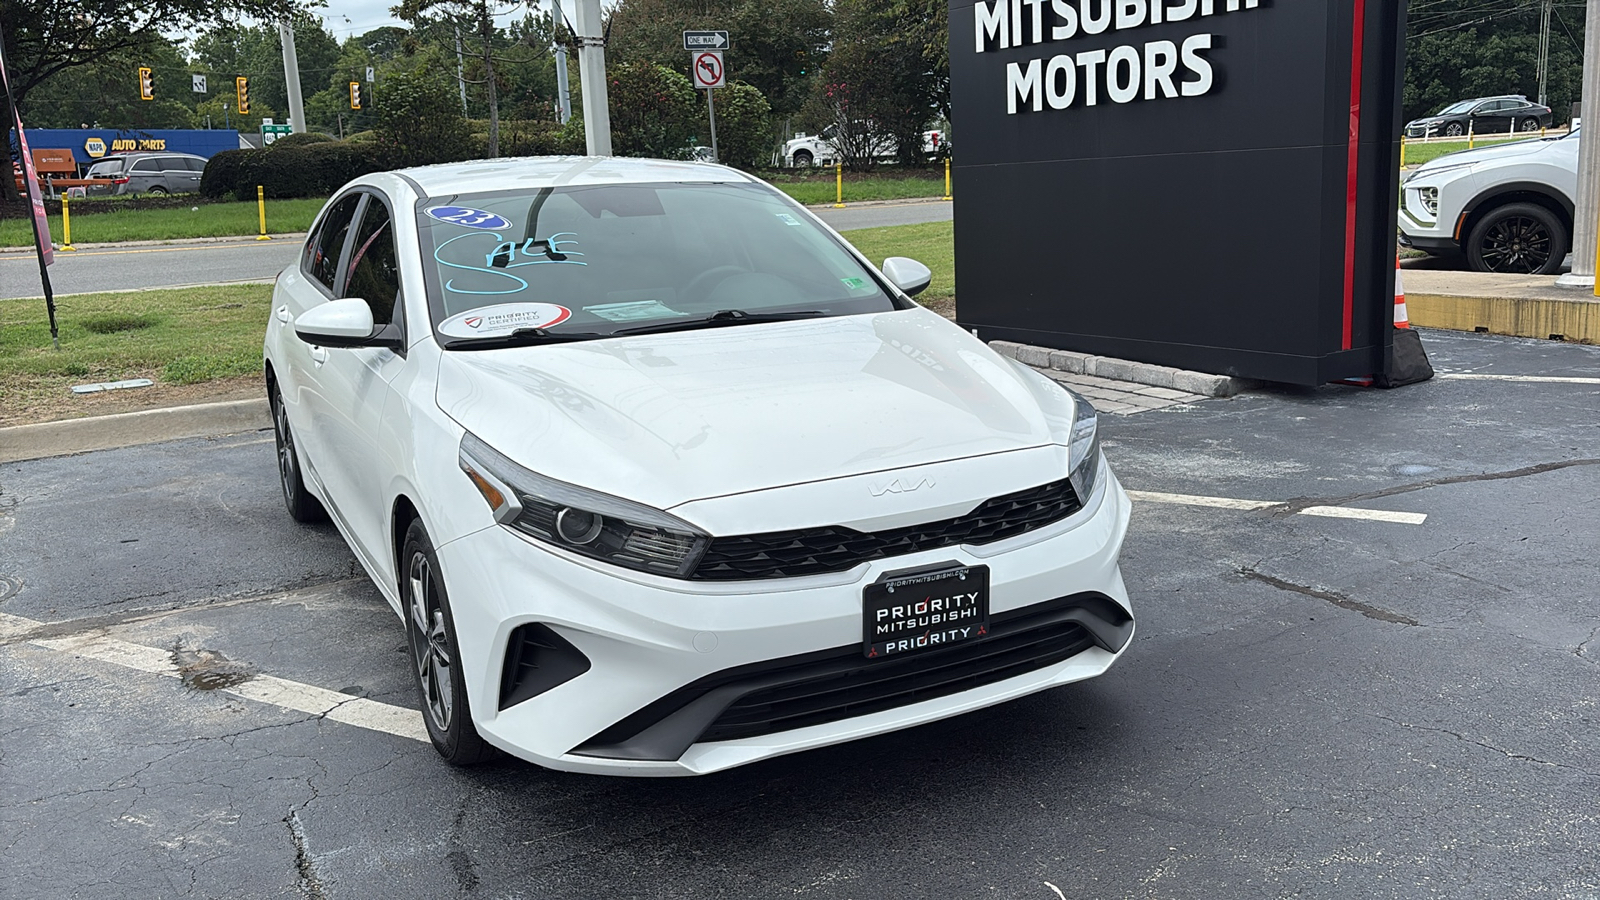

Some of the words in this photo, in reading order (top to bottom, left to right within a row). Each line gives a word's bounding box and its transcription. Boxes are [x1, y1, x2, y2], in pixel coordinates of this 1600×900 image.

[974, 0, 1259, 53] MITSUB
[689, 36, 701, 44] ONE
[703, 36, 715, 44] WAY
[1006, 33, 1213, 115] MOTORS
[88, 143, 104, 152] NAPA
[111, 139, 137, 151] AUTO
[138, 139, 166, 151] PARTS
[440, 209, 495, 224] 23
[434, 231, 584, 295] SALE
[488, 311, 538, 321] PRIORITY
[489, 315, 540, 325] CERTIFIED
[876, 591, 979, 622] PRIORITY
[877, 607, 977, 635] MITSUBISHI
[886, 627, 971, 654] PRIORITY
